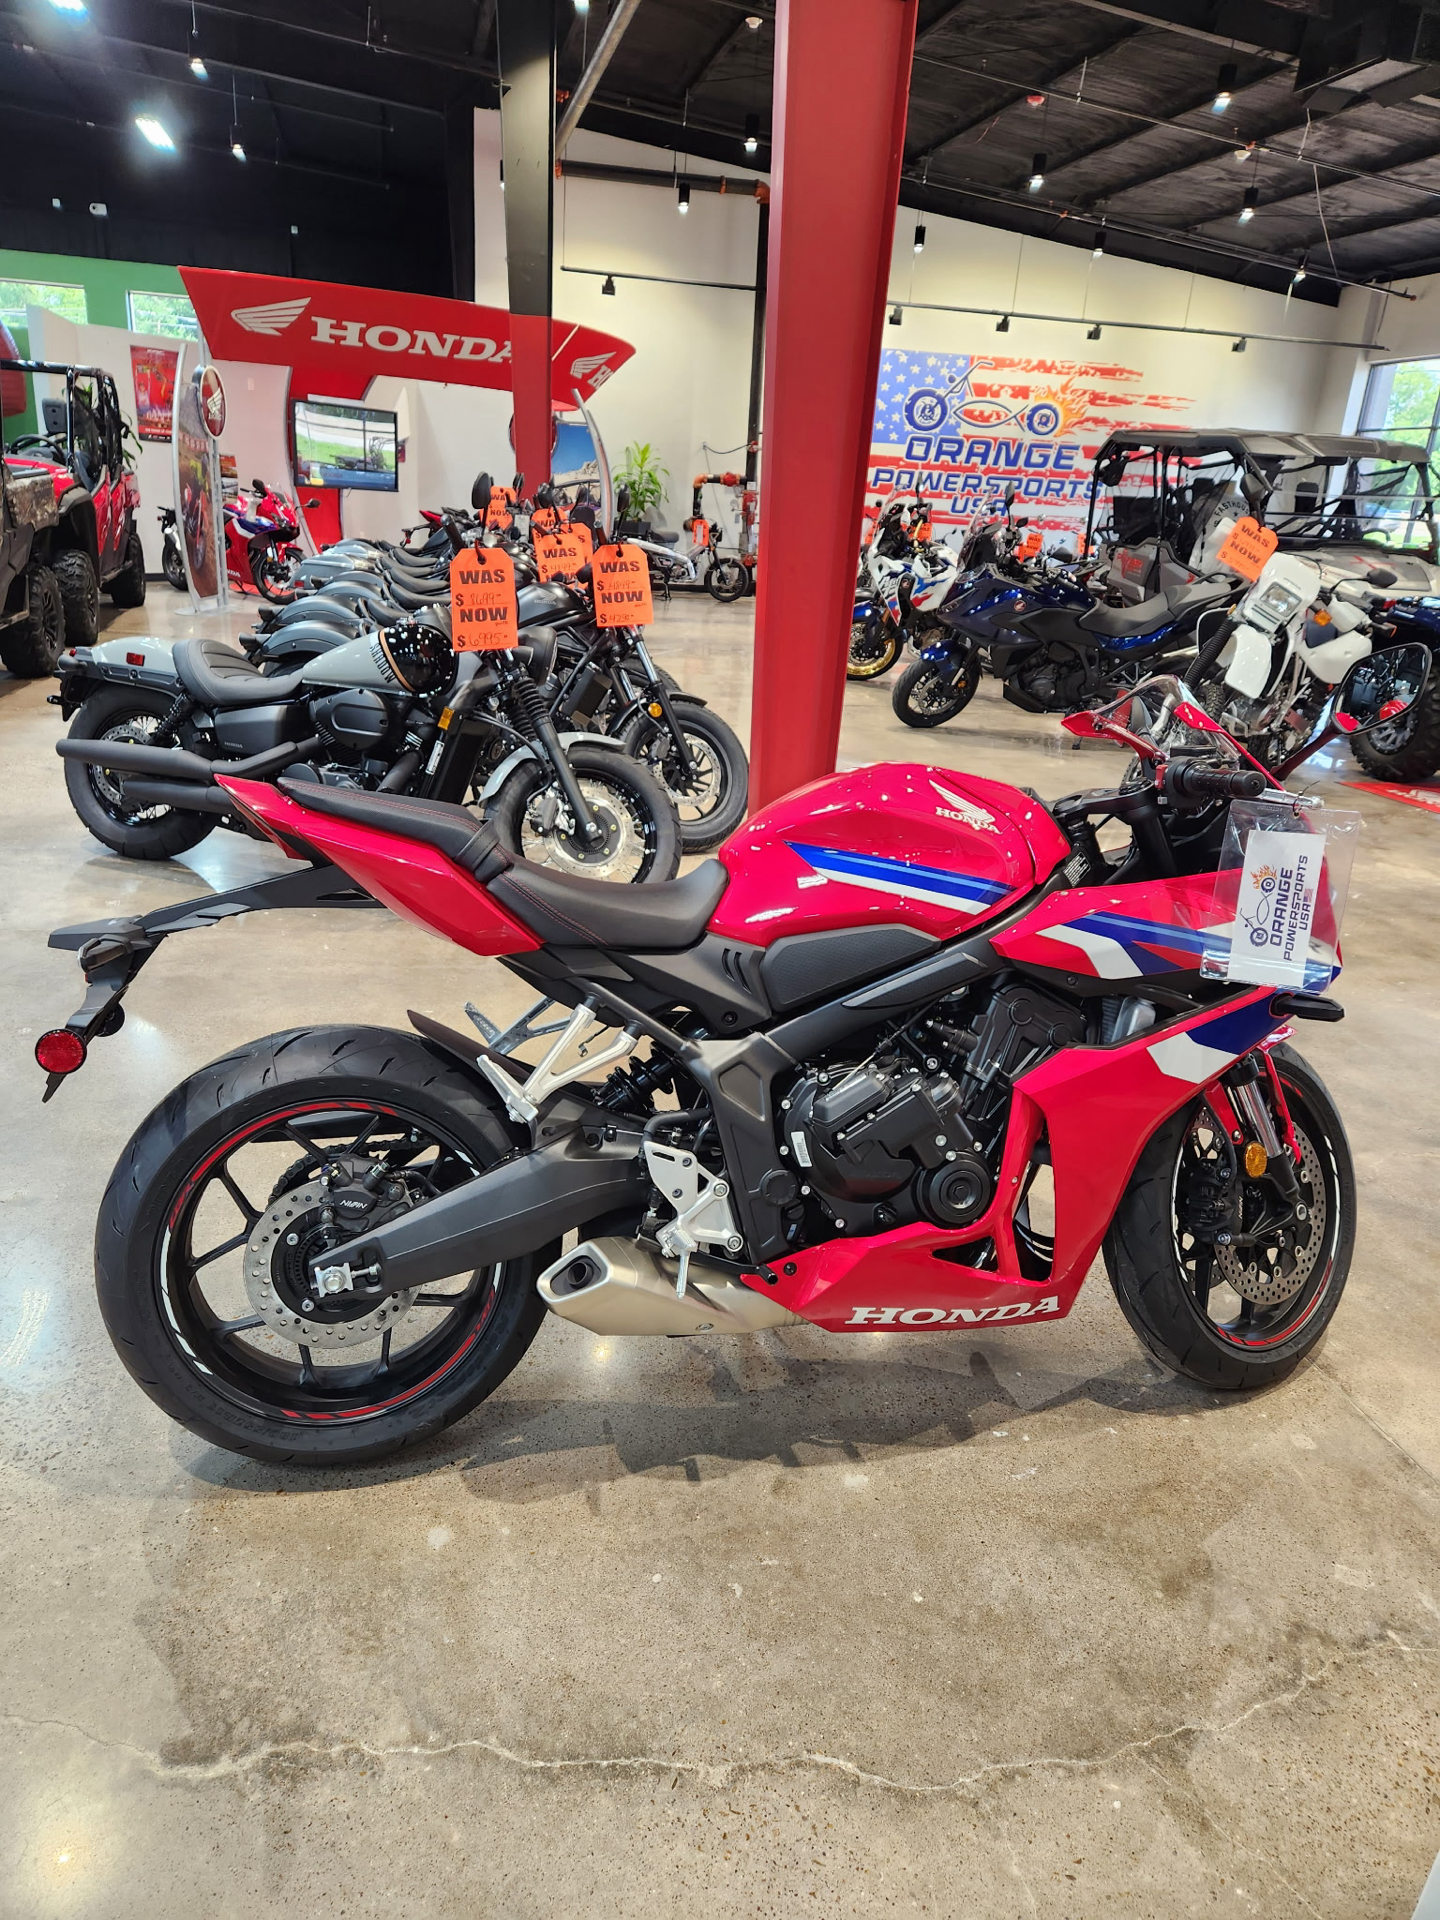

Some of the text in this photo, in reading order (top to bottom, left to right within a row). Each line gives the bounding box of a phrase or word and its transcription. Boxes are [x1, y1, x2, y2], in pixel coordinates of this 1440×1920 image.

[904, 435, 1081, 470] ORANGE
[951, 496, 1006, 517] USA
[1242, 524, 1270, 548] WAS
[543, 547, 577, 559] WAS
[1230, 540, 1261, 564] NOW
[459, 569, 505, 584] WAS
[600, 561, 640, 574] WAS
[601, 590, 643, 604] NOW
[460, 607, 508, 623] NOW
[935, 807, 1001, 834] HONDA
[1270, 867, 1294, 947] ORANGE
[1283, 854, 1309, 962] POWERSPORTS
[1299, 902, 1312, 931] USA
[844, 1295, 1060, 1325] HONDA
